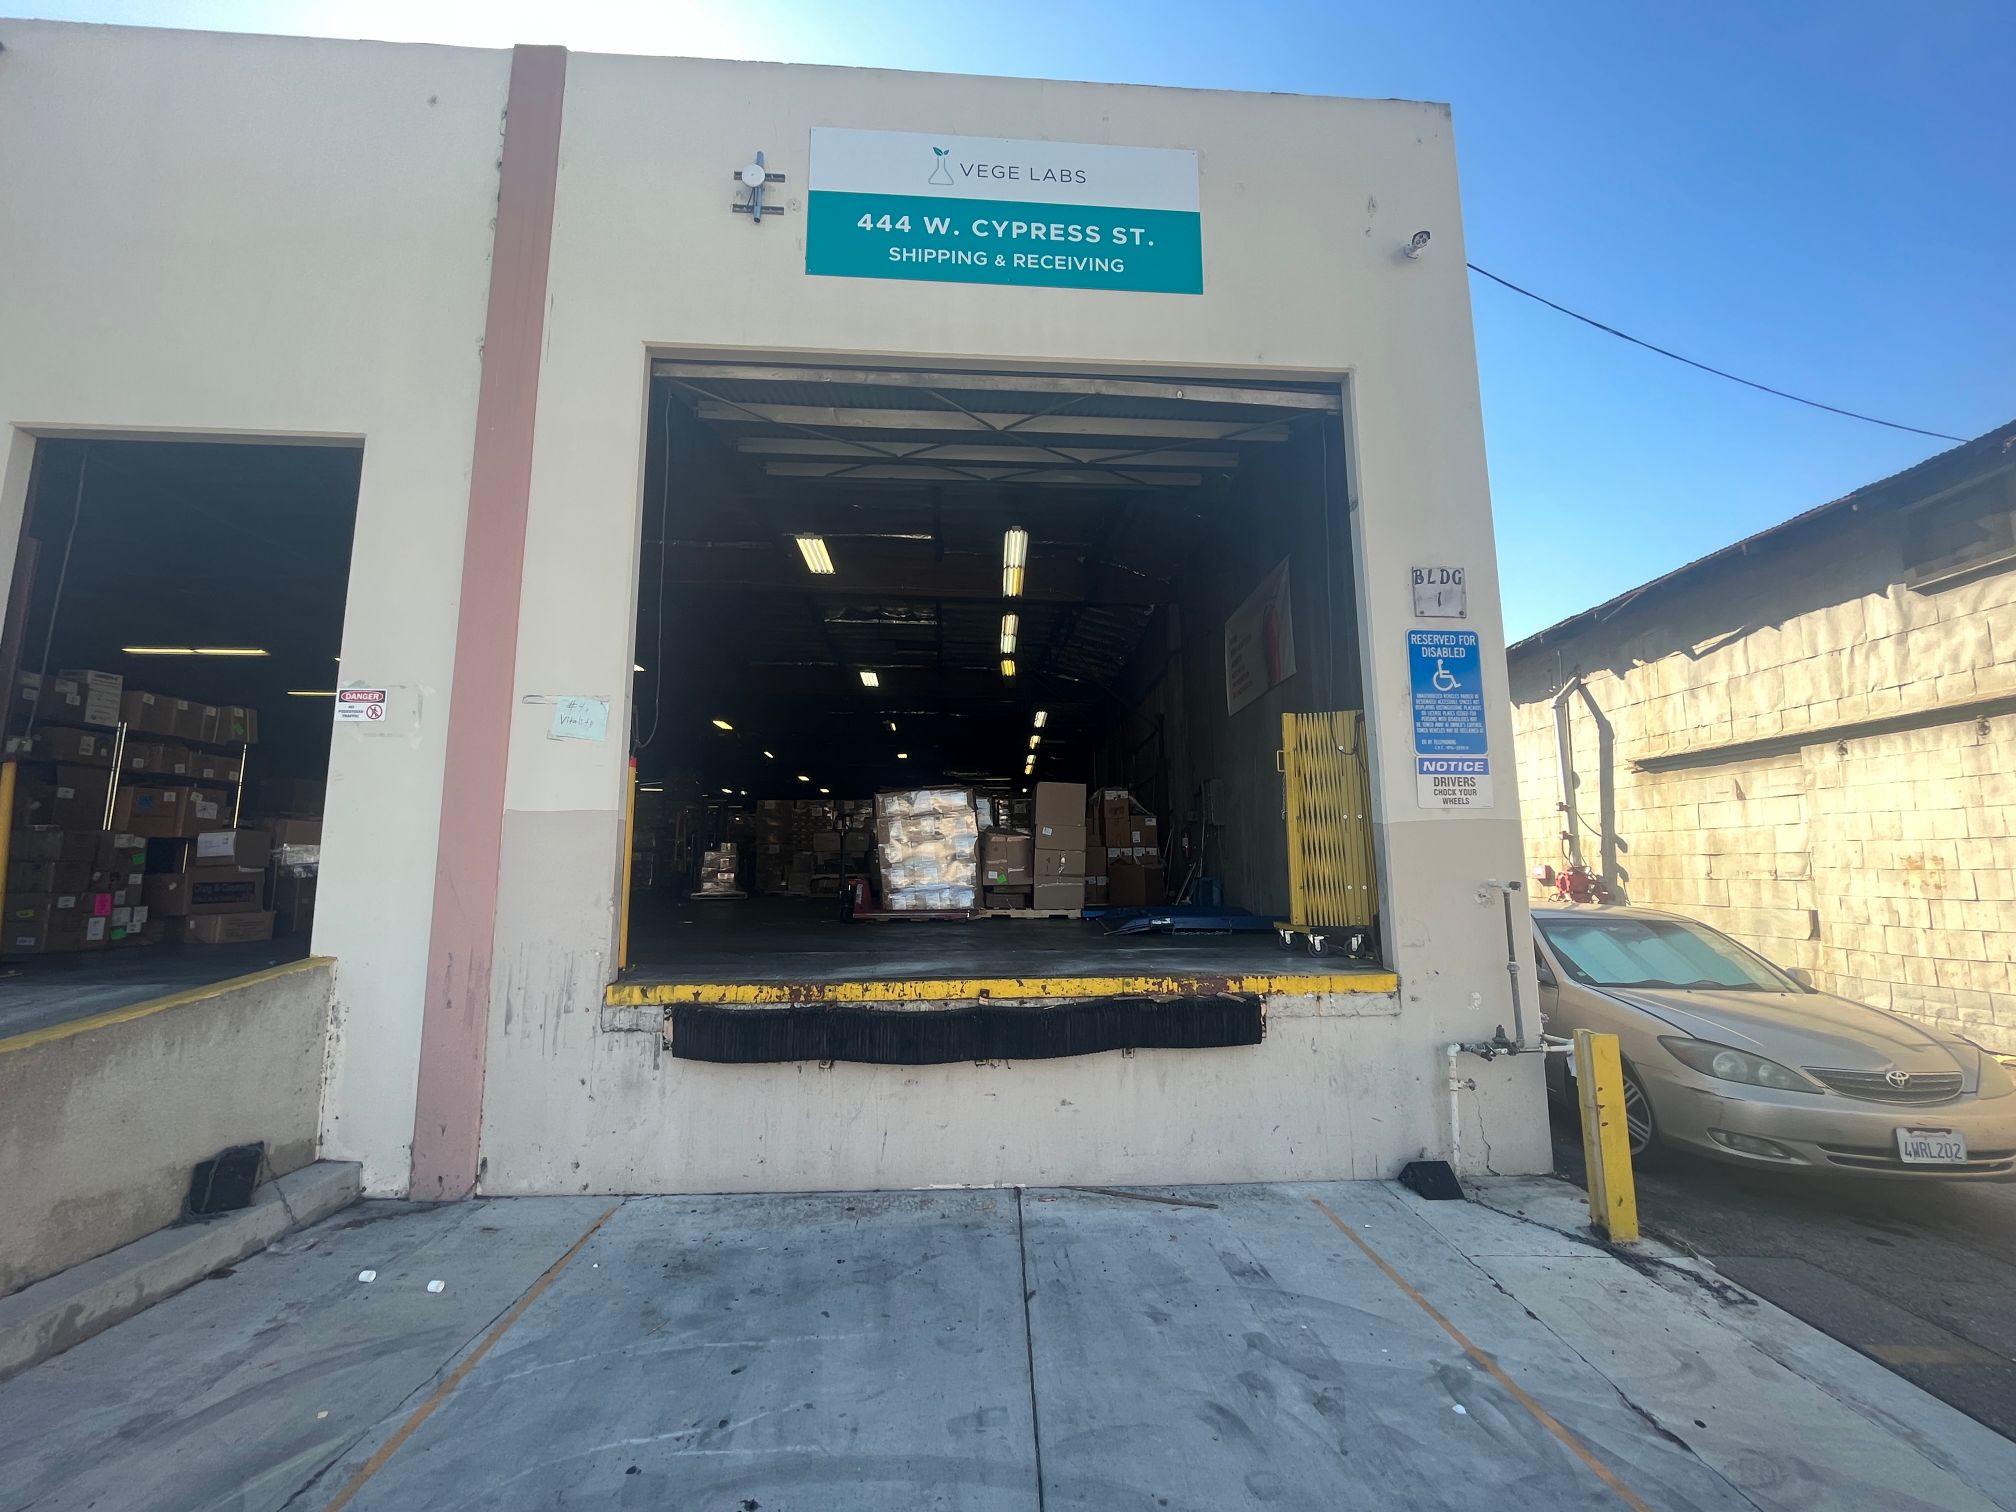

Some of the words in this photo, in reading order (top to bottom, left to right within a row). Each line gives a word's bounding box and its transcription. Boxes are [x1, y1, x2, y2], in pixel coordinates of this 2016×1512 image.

[960, 163, 1020, 180] VEGE
[1030, 167, 1087, 184] LABS
[857, 213, 912, 233] 444
[923, 216, 960, 236] W.
[972, 219, 1101, 243] CYPRESS
[1112, 227, 1154, 246] ST.
[888, 247, 988, 266] SHIPPING
[994, 254, 1006, 267] &
[1013, 253, 1125, 273] RECEIVING
[1413, 569, 1462, 585] BLDG
[1411, 634, 1456, 646] RESERVED
[1458, 635, 1476, 646] FOR
[1421, 646, 1466, 658] DISABLED
[1423, 761, 1484, 772] NOTICE
[1433, 776, 1476, 787] DRIVERS
[1433, 788, 1457, 796] CHOCK
[1459, 788, 1477, 796] YOUR
[1442, 797, 1470, 805] WHEELS
[1904, 1141, 1962, 1159] 4WRL202
